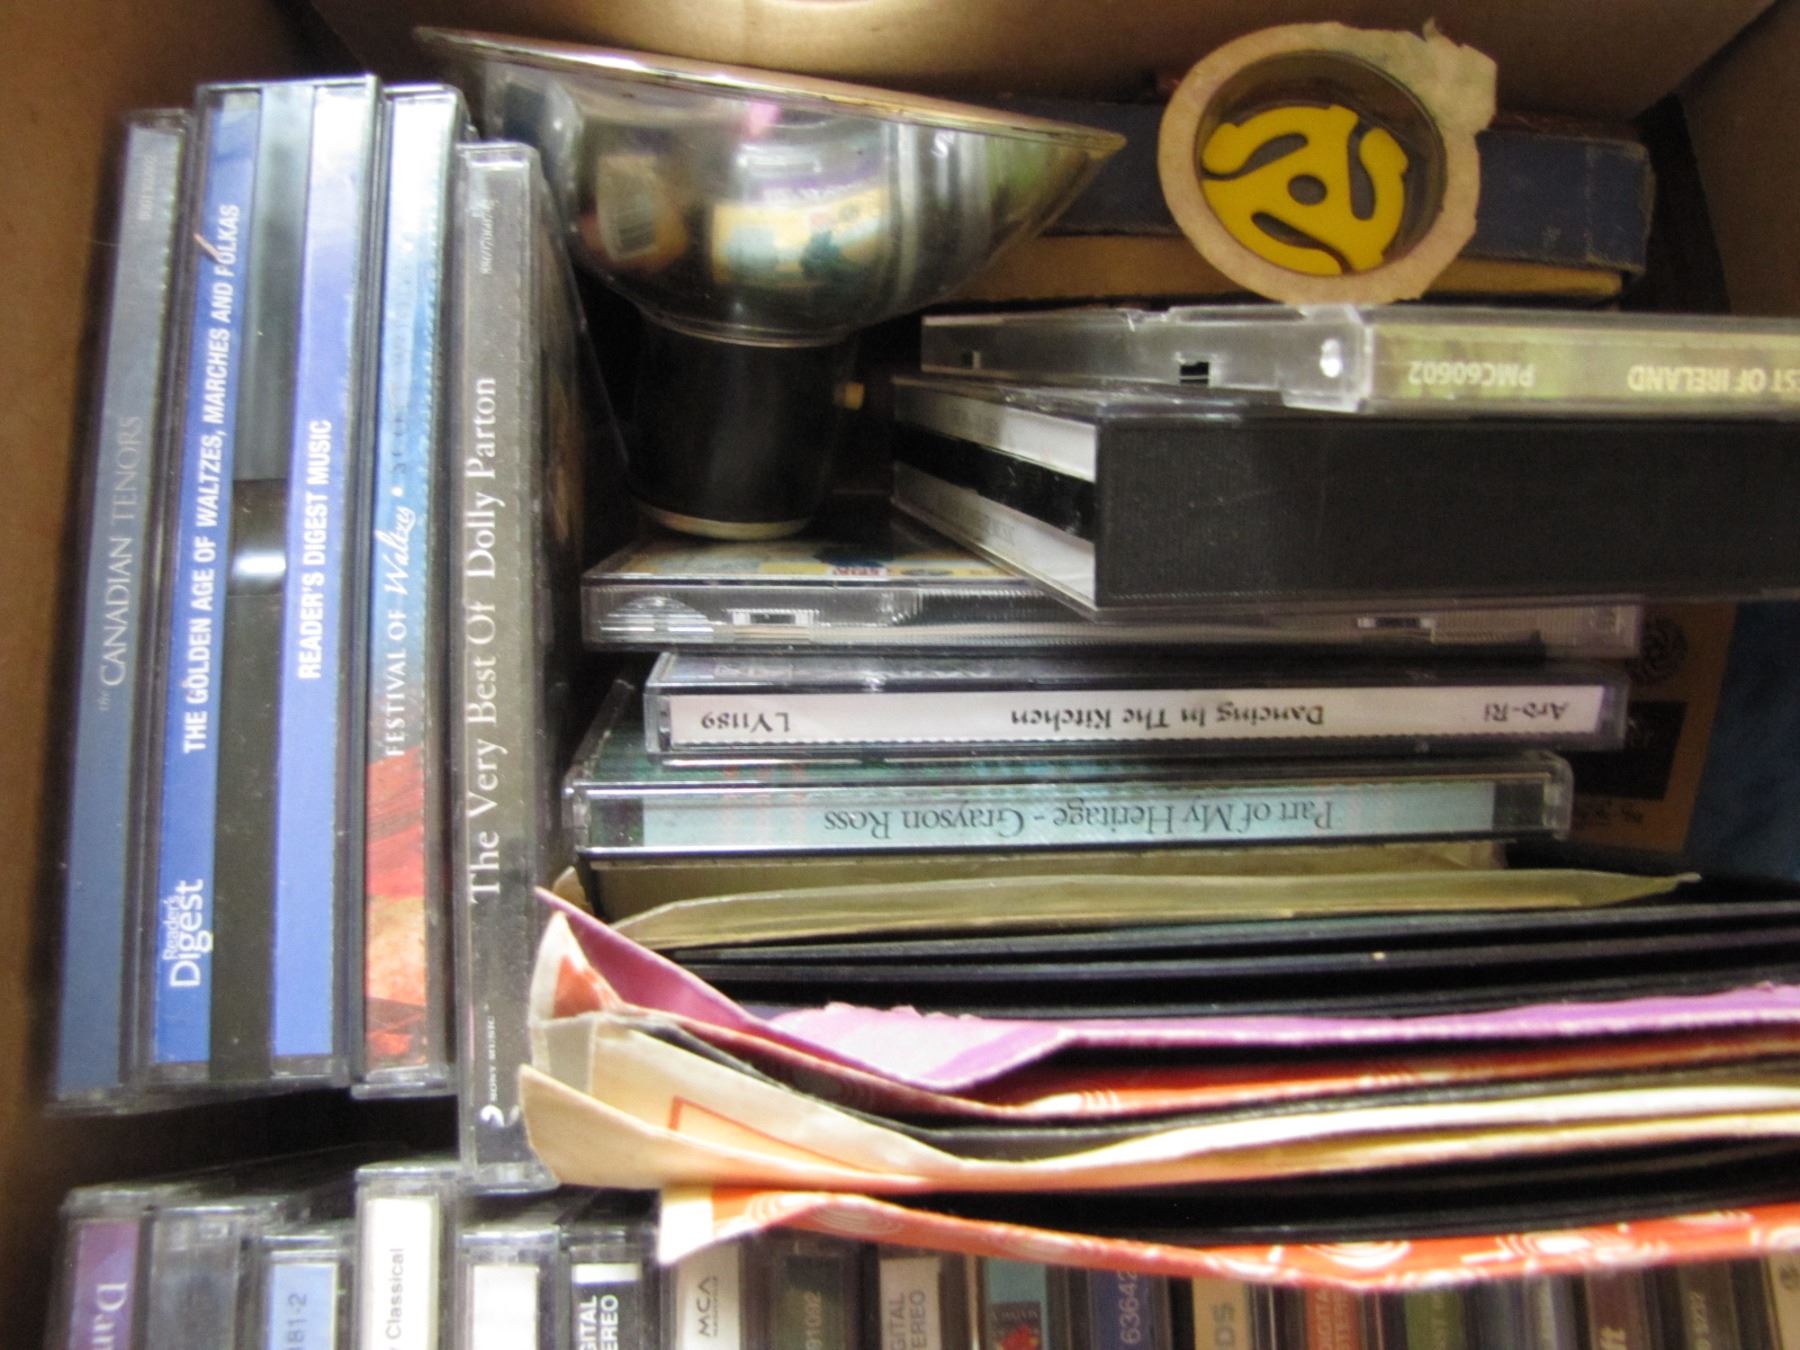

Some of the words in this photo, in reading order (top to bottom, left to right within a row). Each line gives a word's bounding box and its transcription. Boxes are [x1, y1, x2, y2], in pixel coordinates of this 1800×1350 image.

[213, 204, 240, 277] POLKAS
[211, 282, 235, 323] AND
[203, 328, 232, 424] MARCHES
[1408, 361, 1535, 387] PMC60602
[1627, 365, 1731, 392] IRELAND
[1735, 367, 1766, 392] OF
[306, 420, 334, 485] MUSIC
[467, 377, 499, 480] Parton
[112, 416, 143, 522] TENORS
[195, 430, 226, 528] WALTZES,
[193, 535, 215, 563] OF
[304, 491, 330, 565] DIGEST
[374, 505, 417, 596] Waltzes
[464, 492, 505, 578] Dolly
[100, 536, 133, 686] CANADIAN
[190, 569, 214, 611] AGE
[298, 571, 326, 680] READER'S
[387, 610, 408, 641] OF
[463, 600, 497, 645] Of
[185, 618, 212, 703] GOLDEN
[383, 647, 409, 758] FESTIVAL
[464, 656, 499, 725] Best
[1123, 705, 1170, 729] The
[1217, 702, 1325, 725] Dancing
[183, 711, 208, 754] THE
[1011, 708, 1111, 730] Kitchen
[1181, 707, 1206, 728] In
[466, 737, 509, 818] Very
[824, 808, 890, 839] Ross
[904, 800, 1025, 837] Grayson
[1053, 799, 1173, 836] Heritage
[1183, 804, 1234, 834] My
[1242, 803, 1271, 832] of
[1276, 801, 1333, 830] Part
[465, 831, 501, 905] The
[169, 879, 213, 987] Digest
[385, 1247, 405, 1341] Classical
[695, 1276, 711, 1338] MCA
